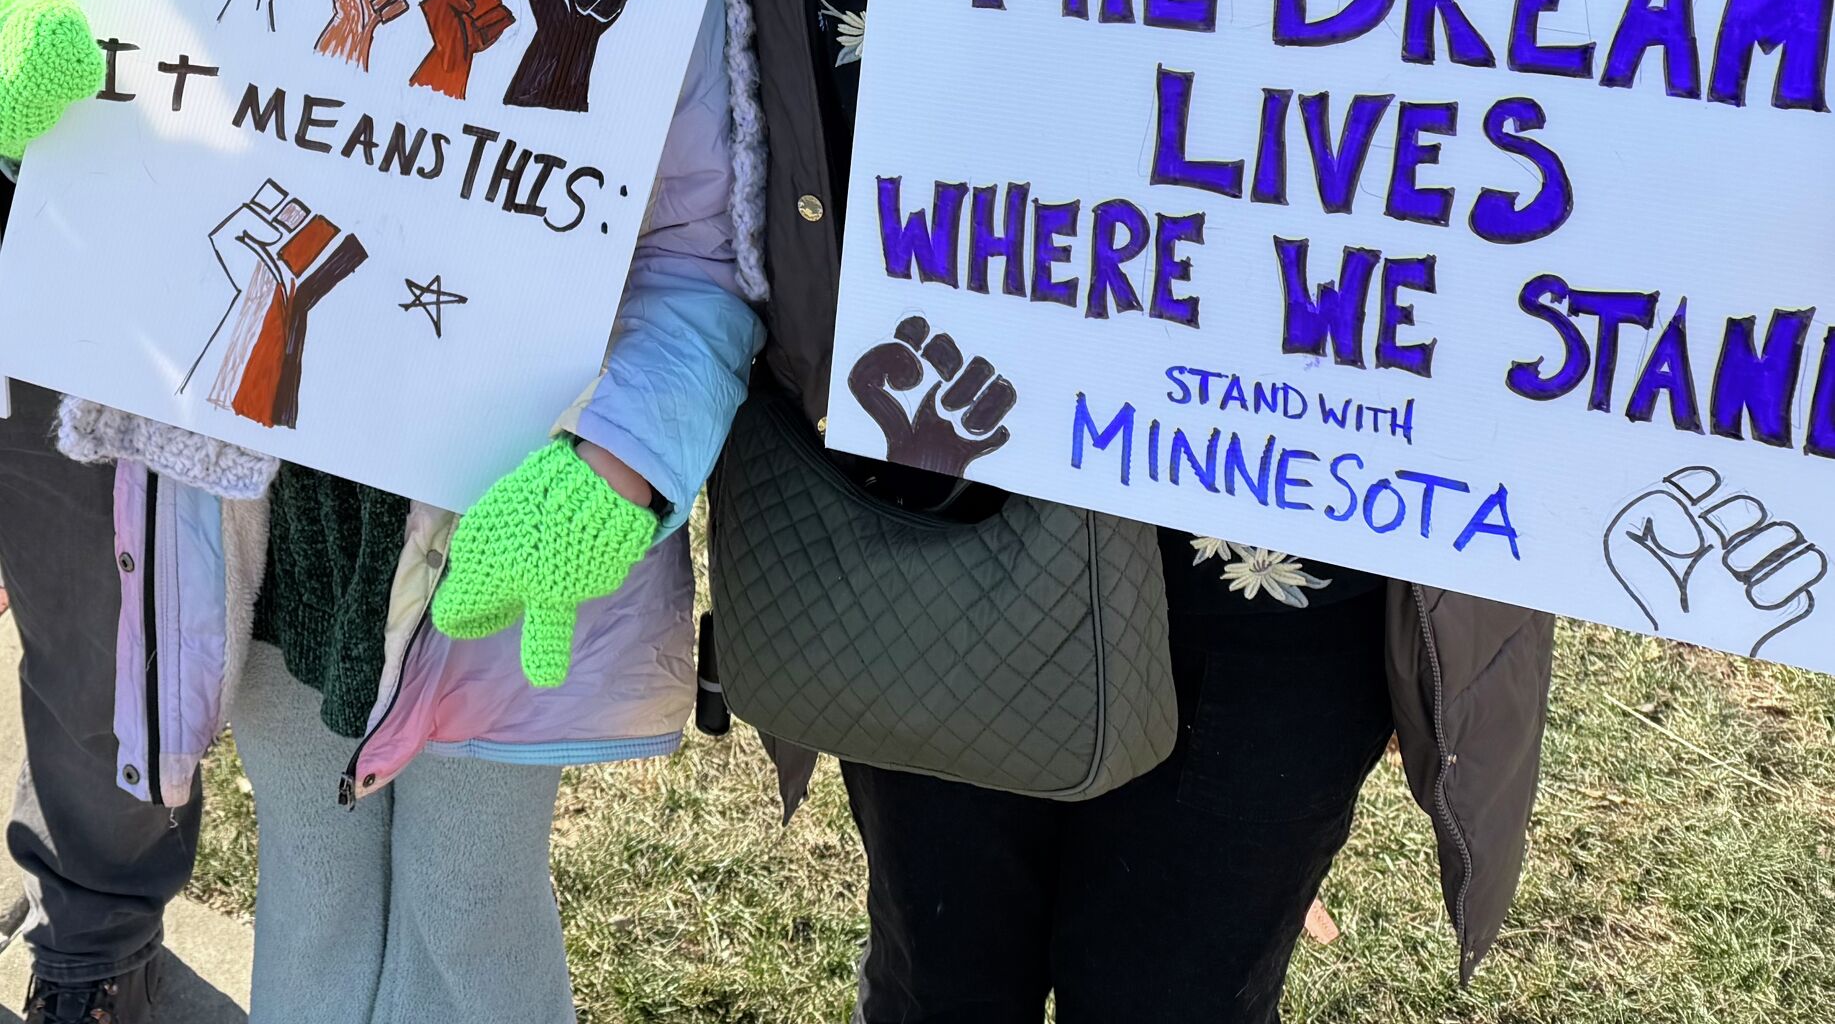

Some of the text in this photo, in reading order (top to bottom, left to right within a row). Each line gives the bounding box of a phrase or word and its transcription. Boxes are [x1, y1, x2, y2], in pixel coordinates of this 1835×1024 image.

[231, 83, 452, 180] MEANS
[1150, 63, 1574, 244] LIVES
[875, 175, 1206, 329] WHERE
[1273, 235, 1438, 378] WE
[1070, 391, 1521, 561] MINNESOTA
[1166, 365, 1415, 445] STAND WITH
